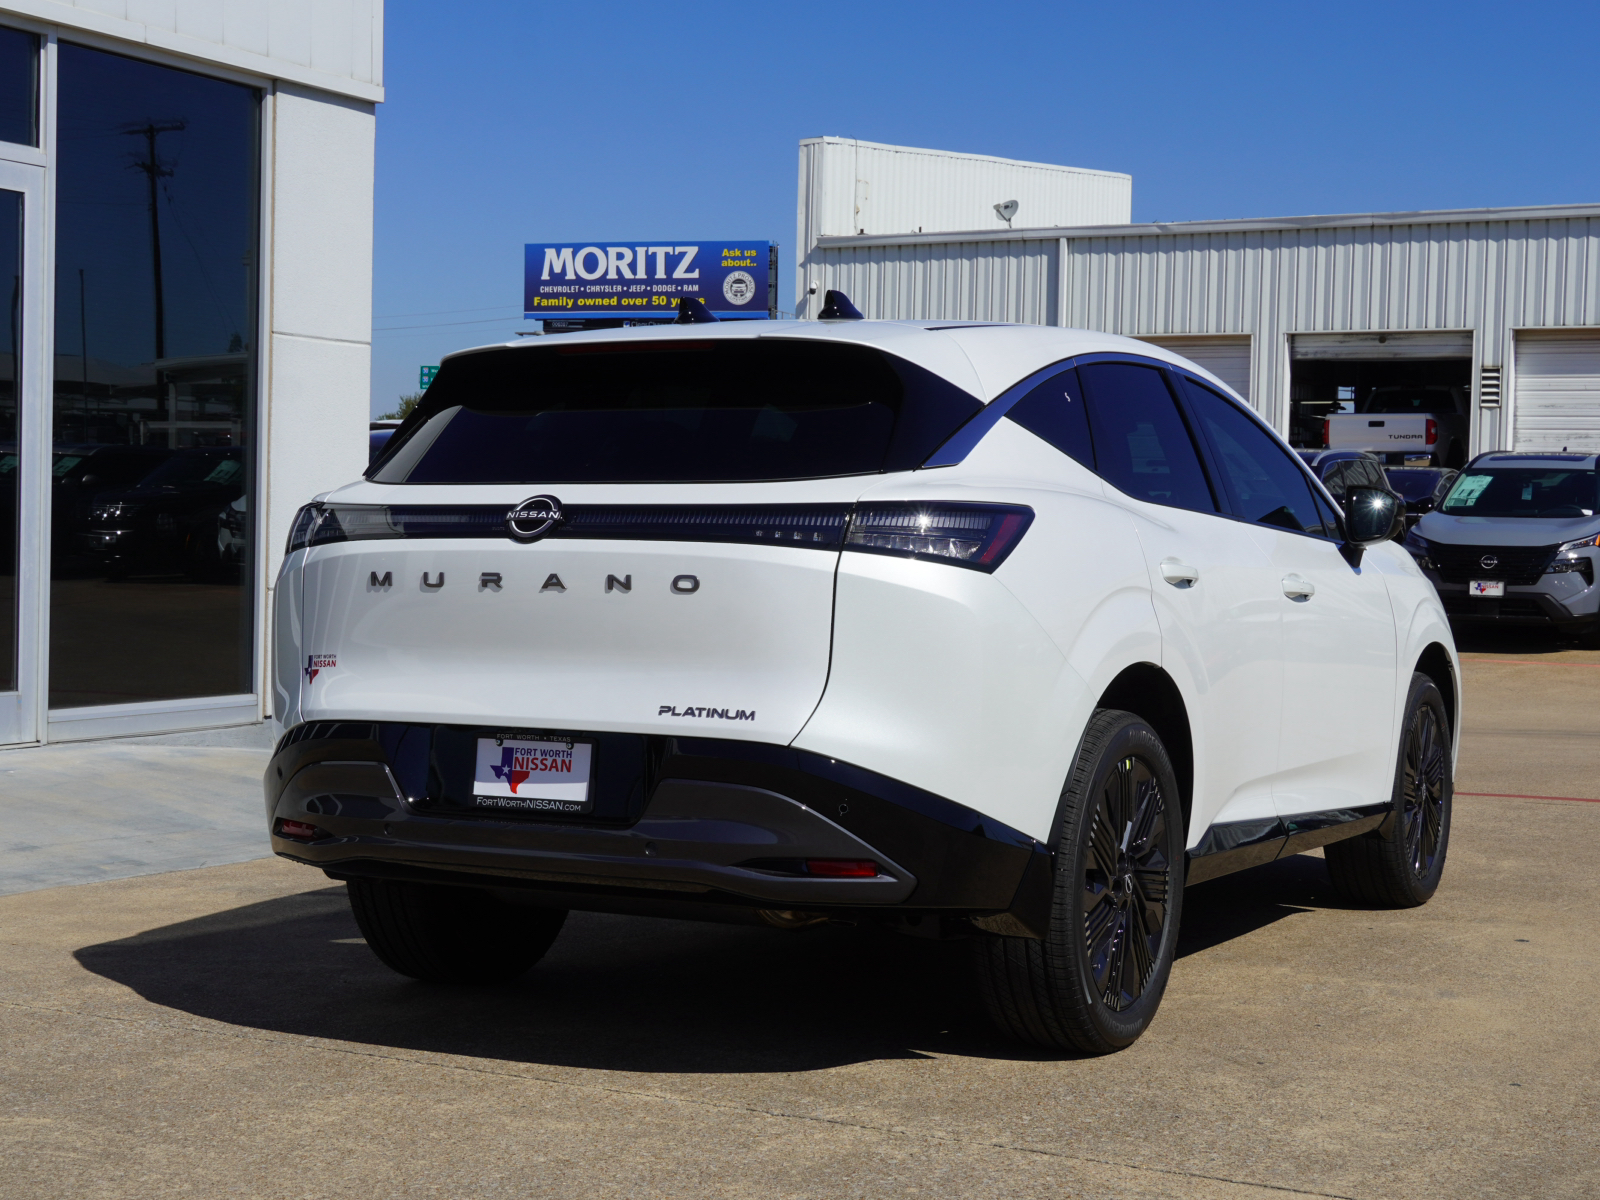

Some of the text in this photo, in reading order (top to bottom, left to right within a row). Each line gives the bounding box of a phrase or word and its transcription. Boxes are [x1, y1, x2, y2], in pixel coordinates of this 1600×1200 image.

[721, 248, 757, 257] Ask us
[541, 246, 699, 280] MORITZ
[540, 284, 699, 293] CHEVROLET CHRYSLER JEEP DODGE RAM
[533, 296, 574, 309] Family
[577, 295, 618, 306] owned
[621, 297, 649, 306] over
[651, 295, 667, 306] 50
[506, 511, 561, 519] NISSAN
[369, 571, 701, 593] MURANO
[658, 705, 756, 721] PLATINUM
[514, 747, 573, 758] FORT WORTH
[513, 756, 573, 773] NISSAN
